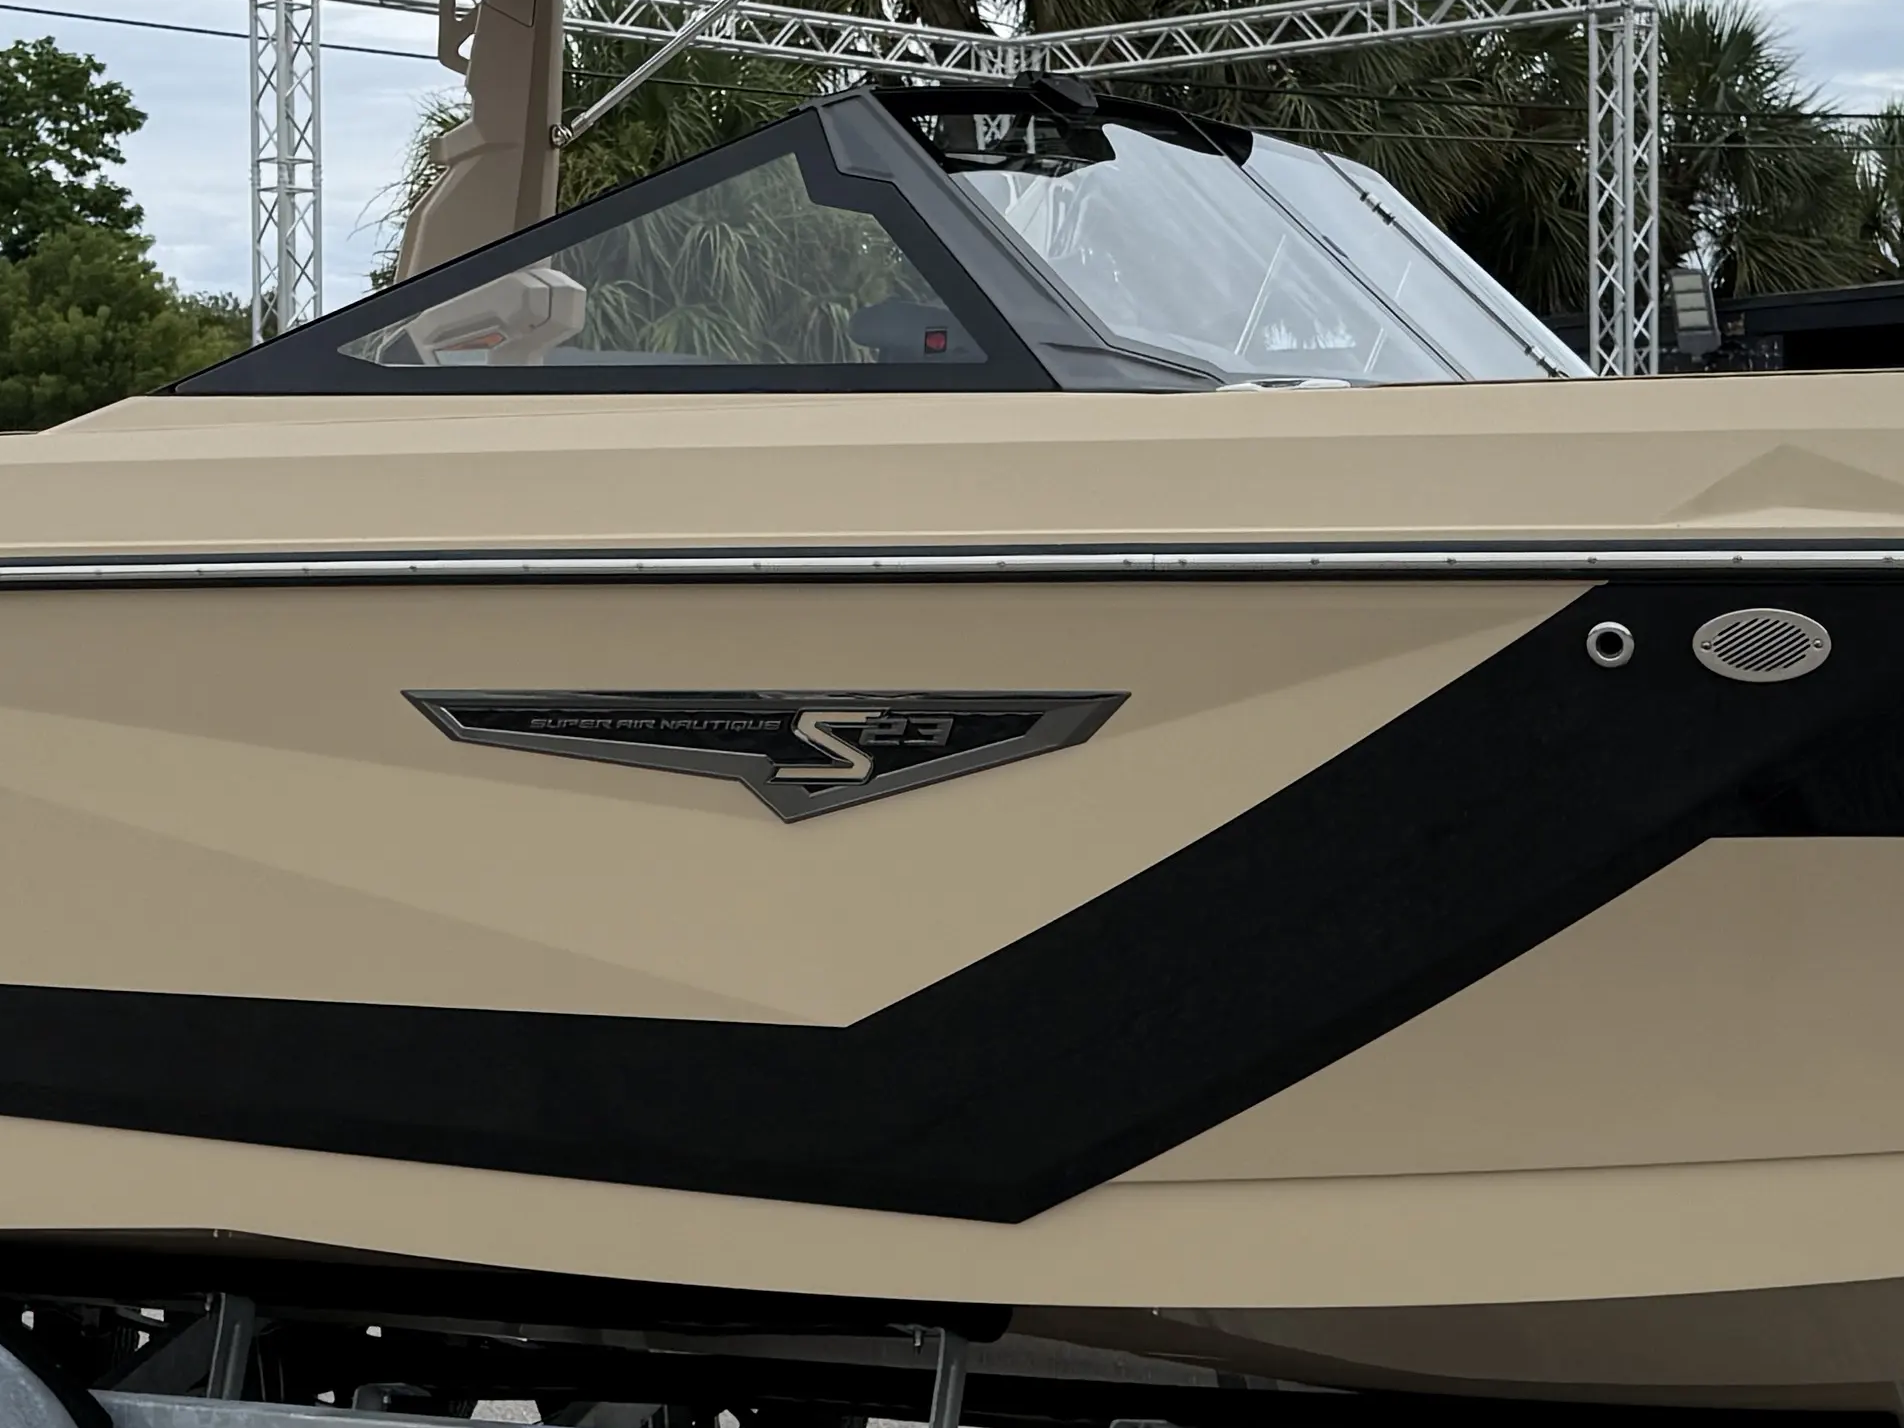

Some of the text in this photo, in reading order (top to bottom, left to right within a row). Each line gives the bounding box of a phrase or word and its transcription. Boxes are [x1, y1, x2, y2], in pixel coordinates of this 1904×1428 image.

[529, 717, 614, 731] SUPER
[615, 717, 656, 731] AIR
[658, 718, 782, 732] NAUTIQUE
